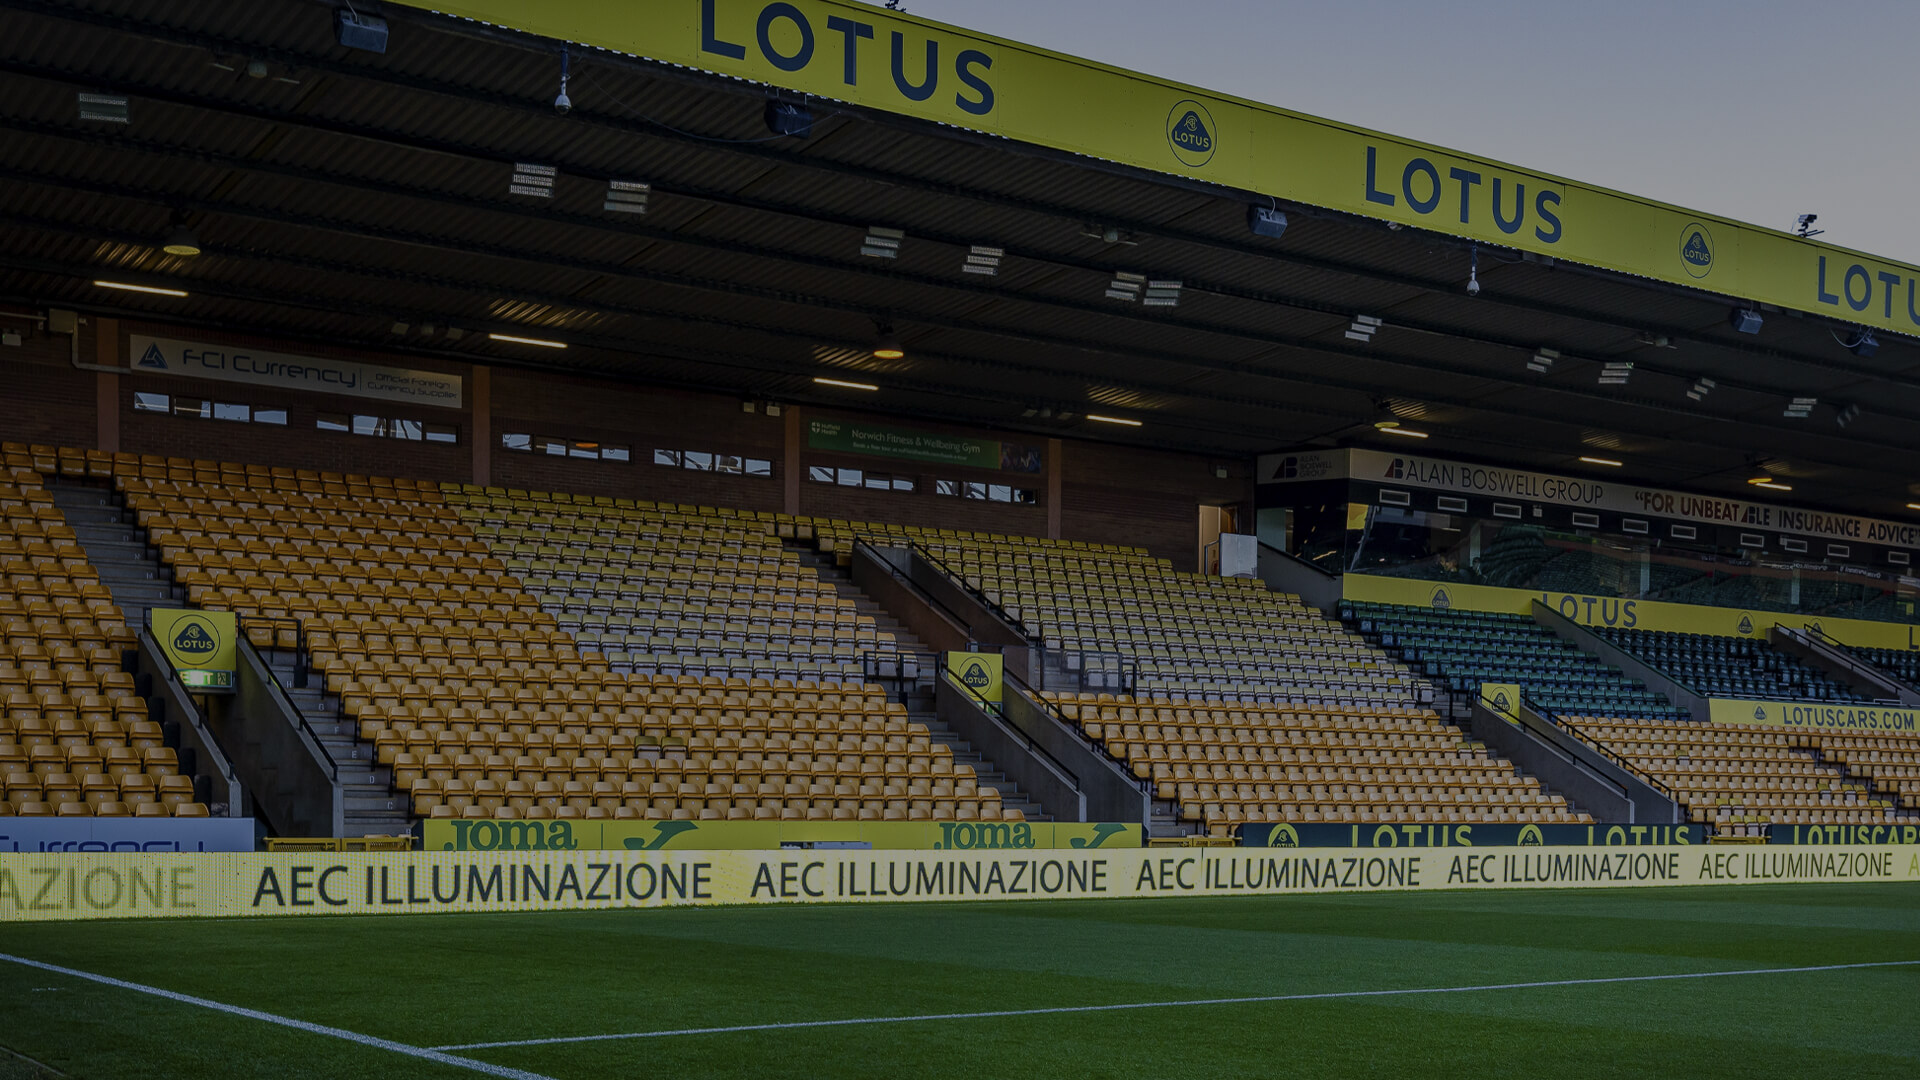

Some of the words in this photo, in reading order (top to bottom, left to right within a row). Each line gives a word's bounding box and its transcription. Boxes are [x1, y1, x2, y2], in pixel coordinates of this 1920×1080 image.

[701, 0, 995, 116] LOTUS
[1174, 130, 1210, 148] LOTUS
[1366, 146, 1562, 244] LOTUS
[1684, 248, 1711, 262] LOTUS
[183, 349, 225, 369] FCI
[233, 355, 356, 388] Currency
[368, 382, 416, 395] Currency
[852, 429, 885, 442] Norwich
[886, 433, 914, 446] Fitness
[916, 436, 922, 446] &
[923, 438, 960, 453] Wellbeing
[962, 442, 980, 454] Gym
[1406, 460, 1454, 485] ALAN
[1462, 467, 1540, 498] BOSWELL
[1542, 478, 1604, 504] GROUP
[1778, 510, 1860, 538] INSURANCE
[176, 640, 213, 649] LOTUS
[963, 675, 988, 685] LOTUS
[1783, 706, 1915, 730] LOTUSCARS.COM
[750, 862, 825, 898] AEC
[838, 860, 1107, 896] ILLUMINAZIONE
[1136, 858, 1196, 890] AEC
[1206, 856, 1421, 889] ILLUMINAZIONE
[1448, 854, 1496, 884] AEC
[1504, 853, 1679, 882] ILLUMINAZIONE
[1699, 853, 1739, 879] AEC
[1745, 852, 1892, 878] ILLUMINAZIONE
[252, 866, 348, 907] AEC
[366, 862, 712, 905] ILLUMINAZIONE
